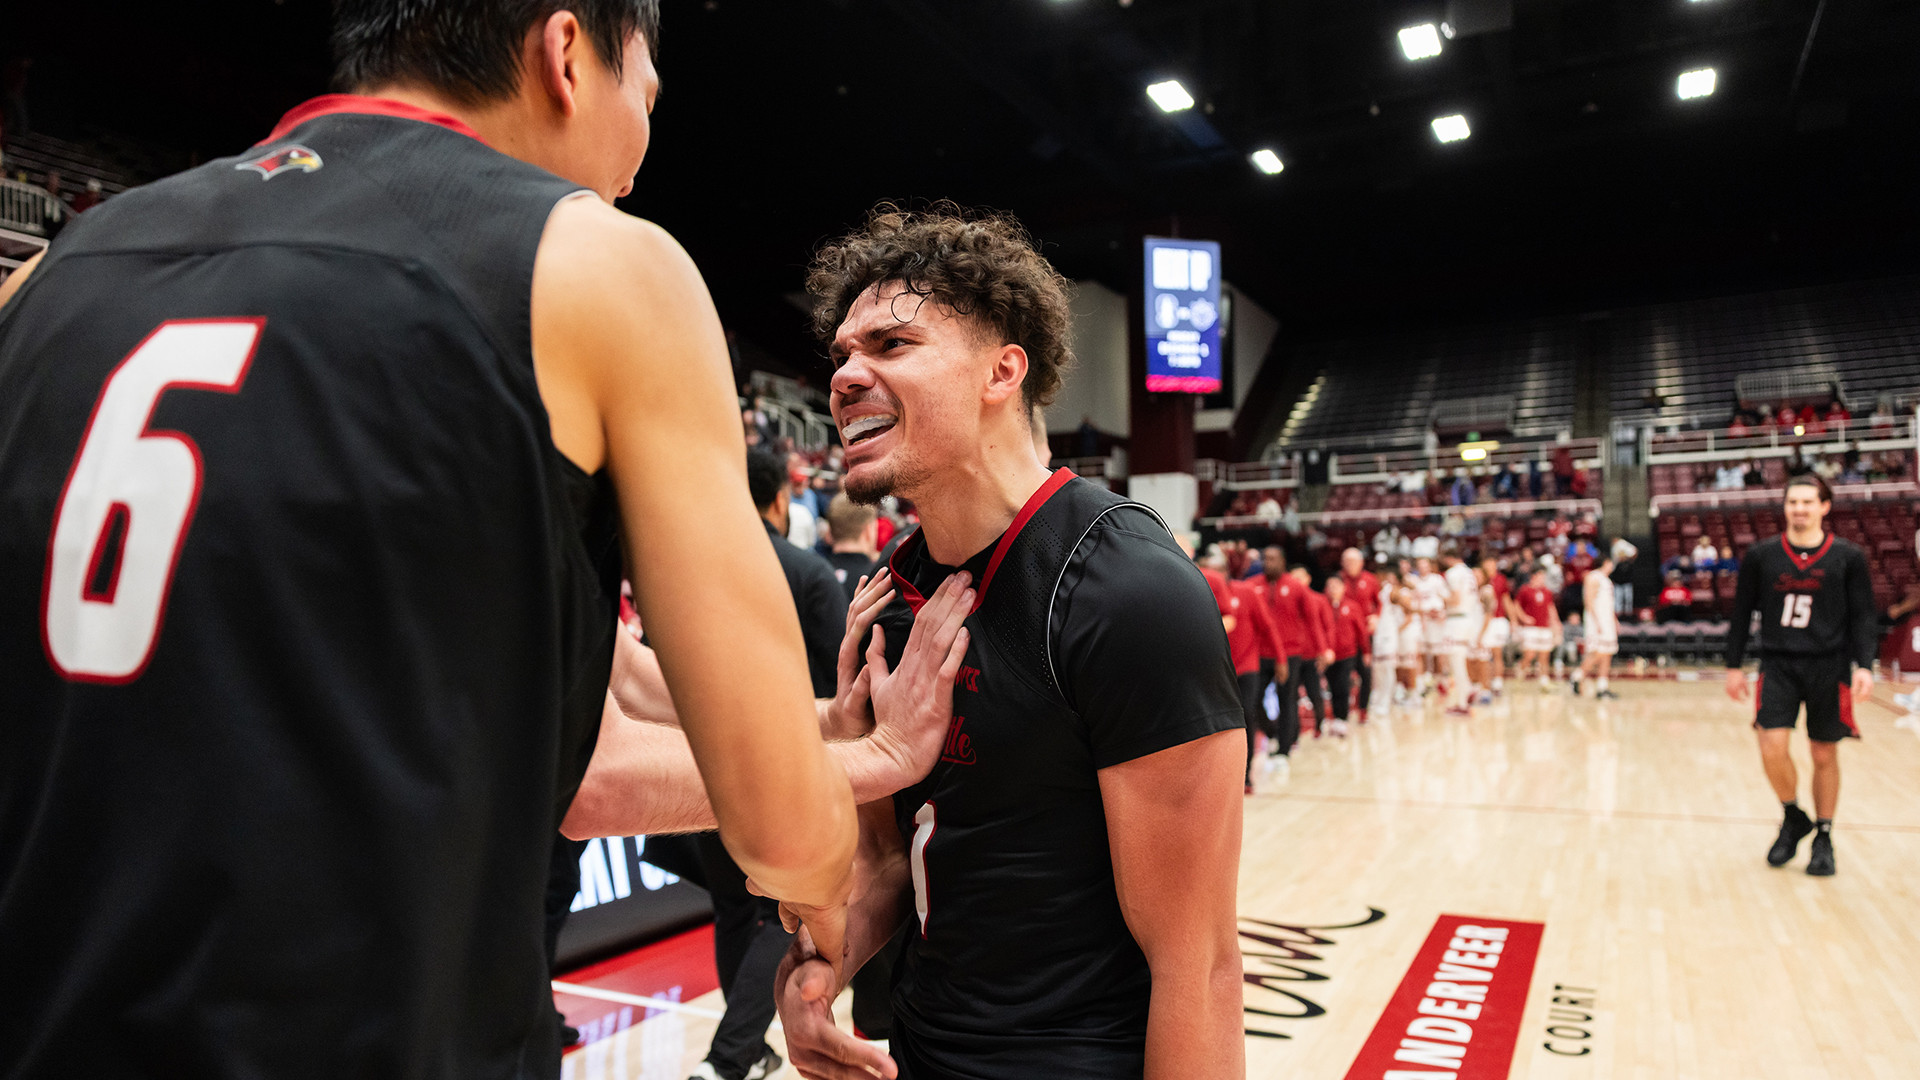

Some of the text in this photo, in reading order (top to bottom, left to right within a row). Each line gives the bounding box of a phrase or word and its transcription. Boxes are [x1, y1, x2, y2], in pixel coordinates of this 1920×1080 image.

[40, 316, 267, 685] 6
[1780, 593, 1813, 628] 15
[1543, 984, 1596, 1056] COURT
